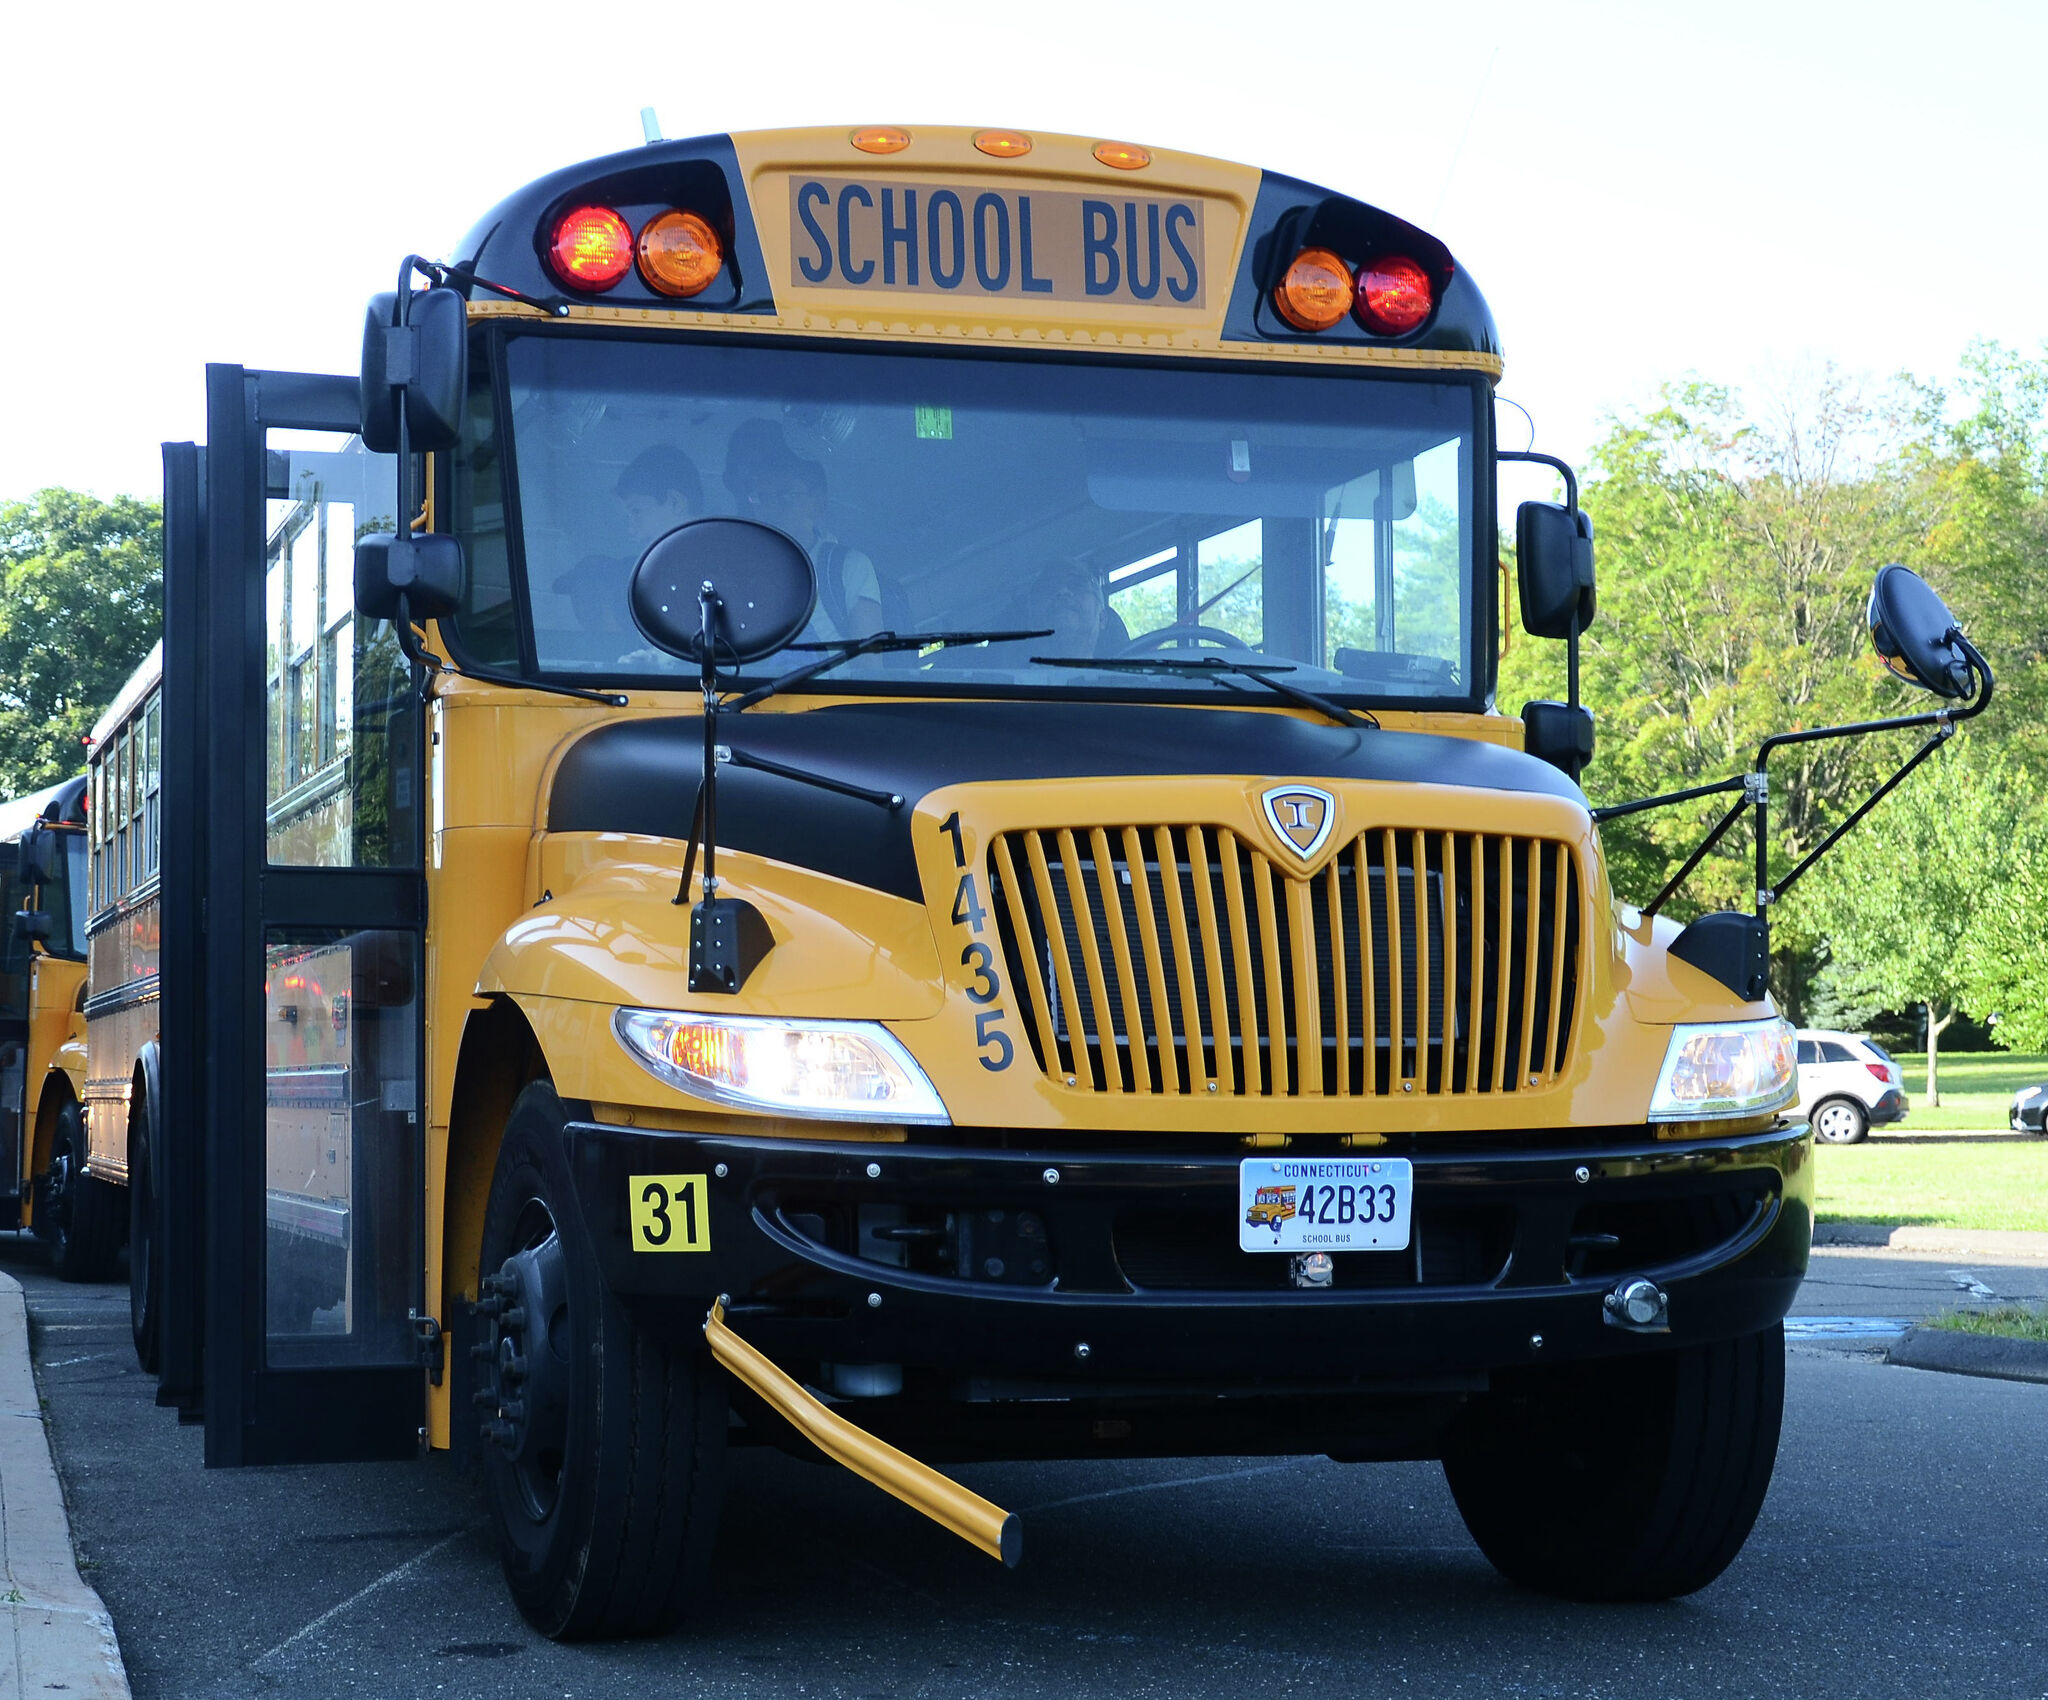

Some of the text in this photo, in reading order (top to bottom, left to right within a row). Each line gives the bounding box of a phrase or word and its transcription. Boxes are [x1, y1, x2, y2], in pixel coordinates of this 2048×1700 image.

[797, 181, 1199, 303] SCHOOL BUS
[938, 810, 1015, 1073] 1435
[1284, 1164, 1369, 1178] CONNECTICUT
[641, 1181, 698, 1246] 31
[1298, 1183, 1397, 1225] 42B33
[1302, 1234, 1351, 1244] SCHOOL BUS
